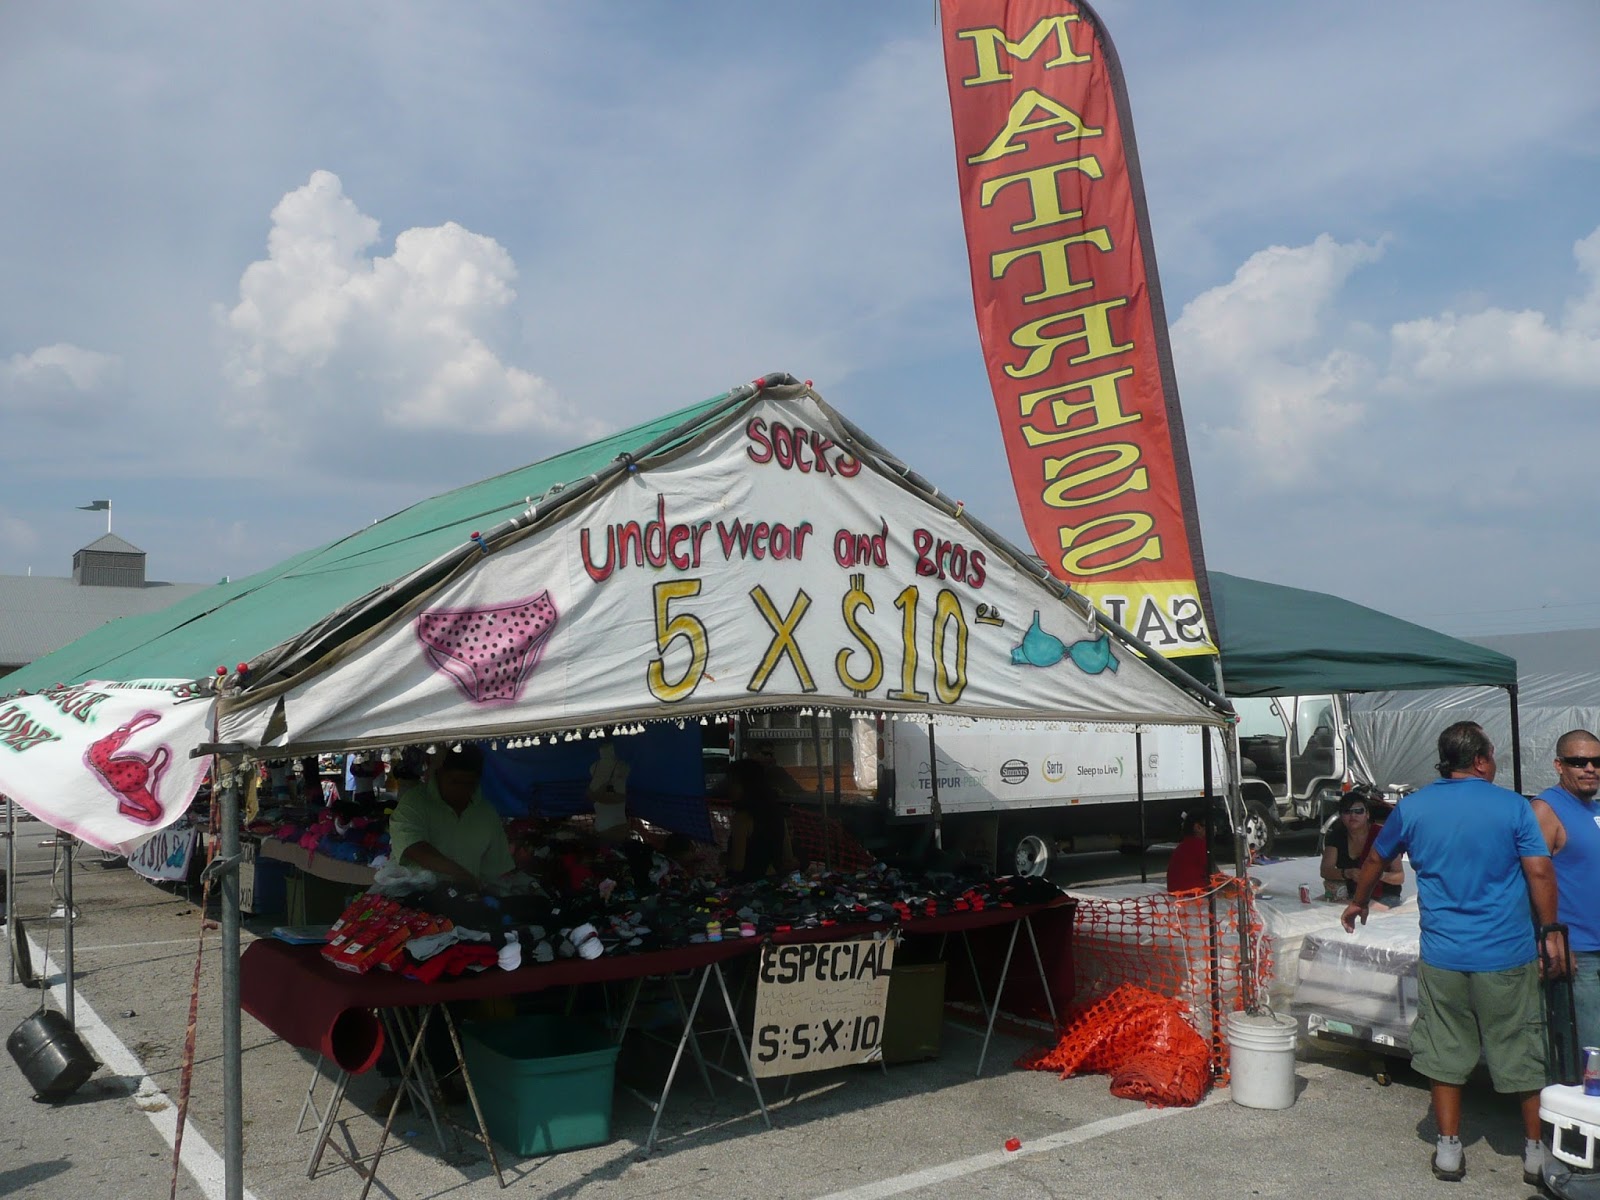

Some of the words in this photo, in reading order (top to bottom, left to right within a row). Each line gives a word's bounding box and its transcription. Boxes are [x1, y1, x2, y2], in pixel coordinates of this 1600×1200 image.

[746, 416, 862, 478] SOCKS
[833, 515, 889, 569] and
[912, 527, 987, 589] Bras
[646, 578, 709, 703] 5
[746, 584, 819, 693] X
[1002, 768, 1028, 777] Simmons
[1046, 760, 1063, 775] Serta
[1077, 765, 1097, 777] Sleep
[1097, 767, 1104, 775] to
[1104, 764, 1119, 775] Live
[760, 942, 893, 984] ESPECIAL
